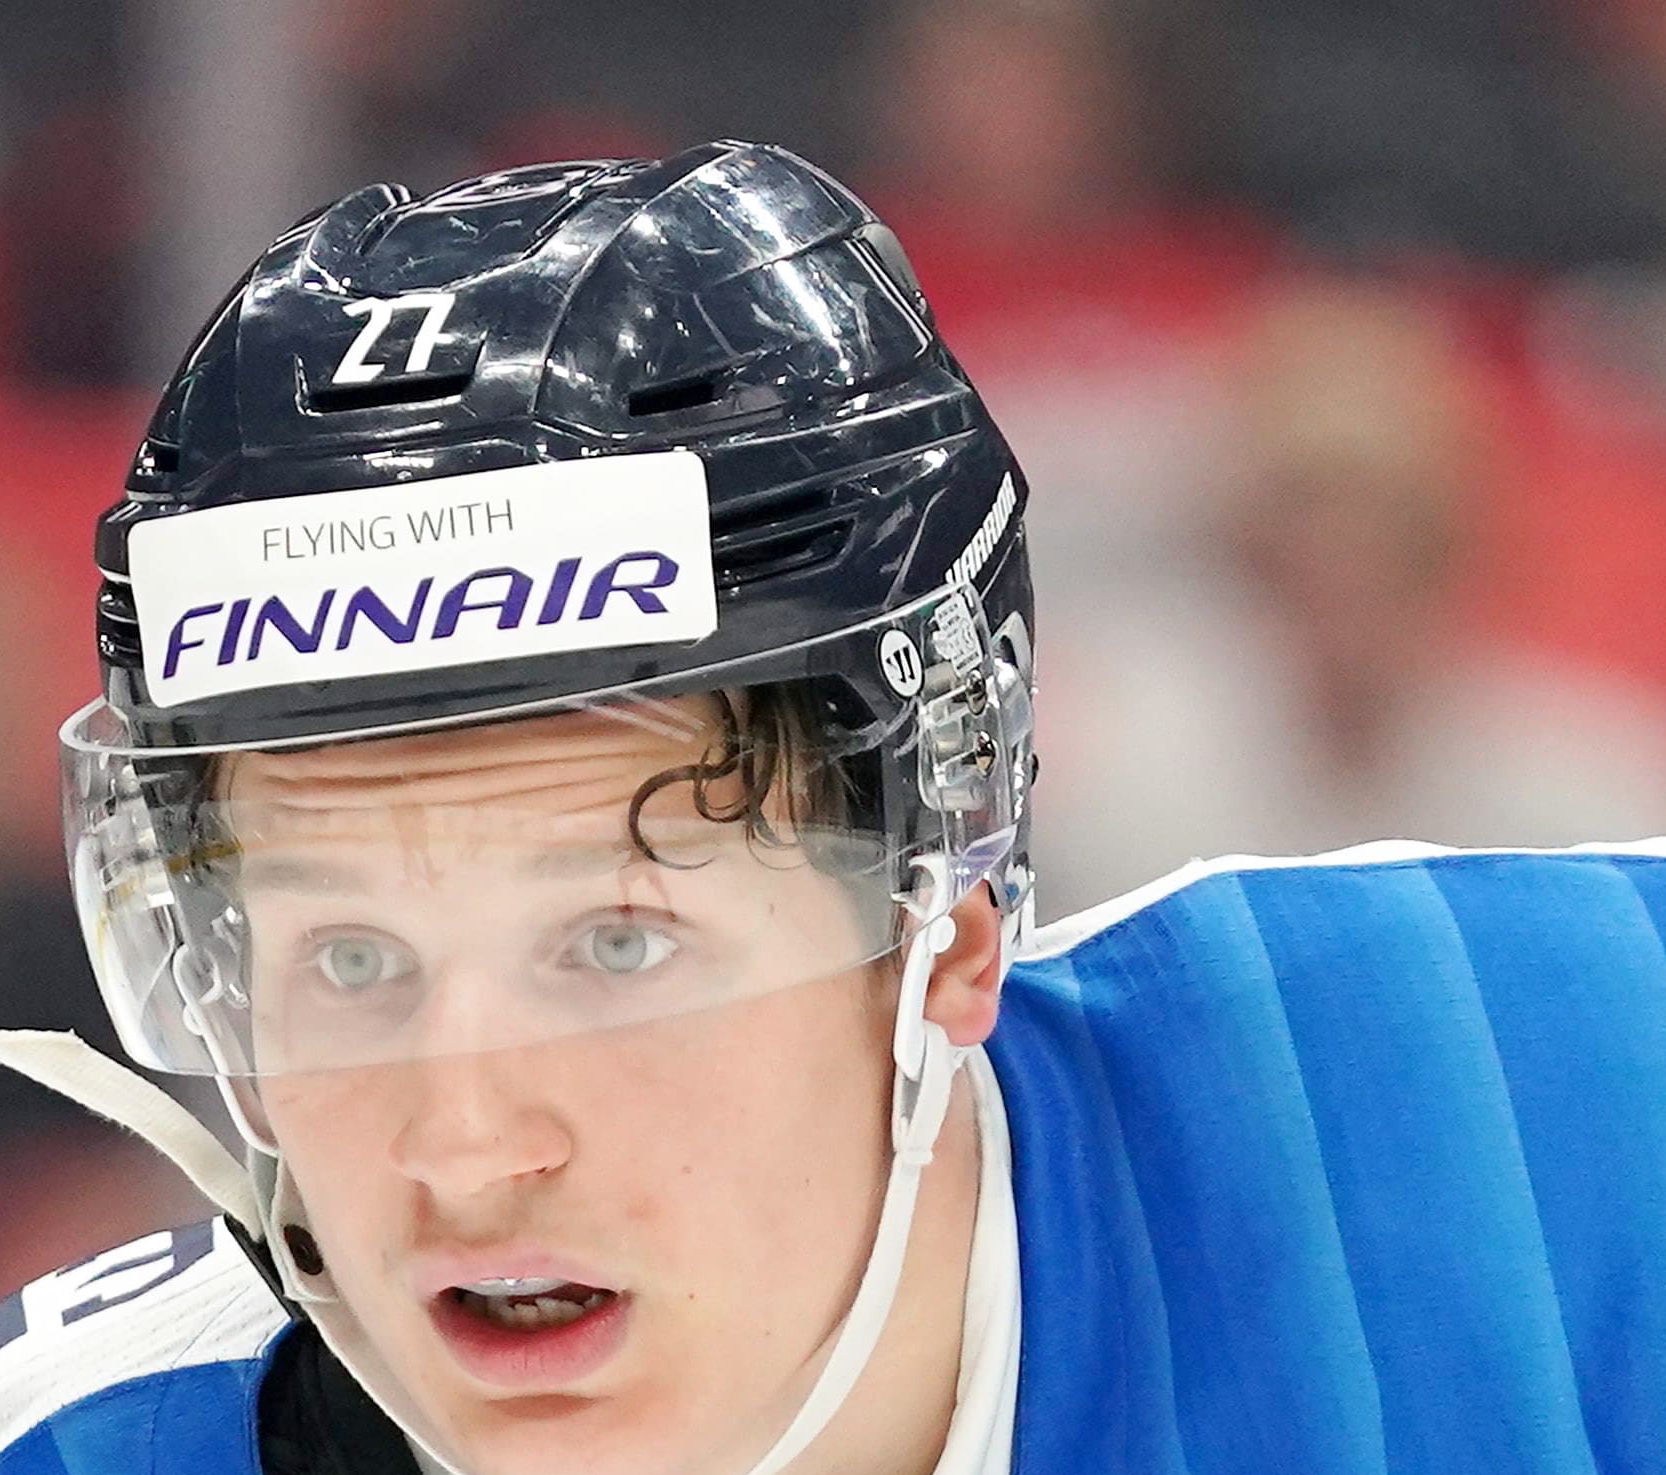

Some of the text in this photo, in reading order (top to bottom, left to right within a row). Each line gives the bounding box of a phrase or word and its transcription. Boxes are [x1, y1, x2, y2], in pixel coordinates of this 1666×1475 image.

[331, 294, 456, 384] 27
[260, 499, 515, 562] FLYING WITH
[162, 551, 679, 680] FINNAIR
